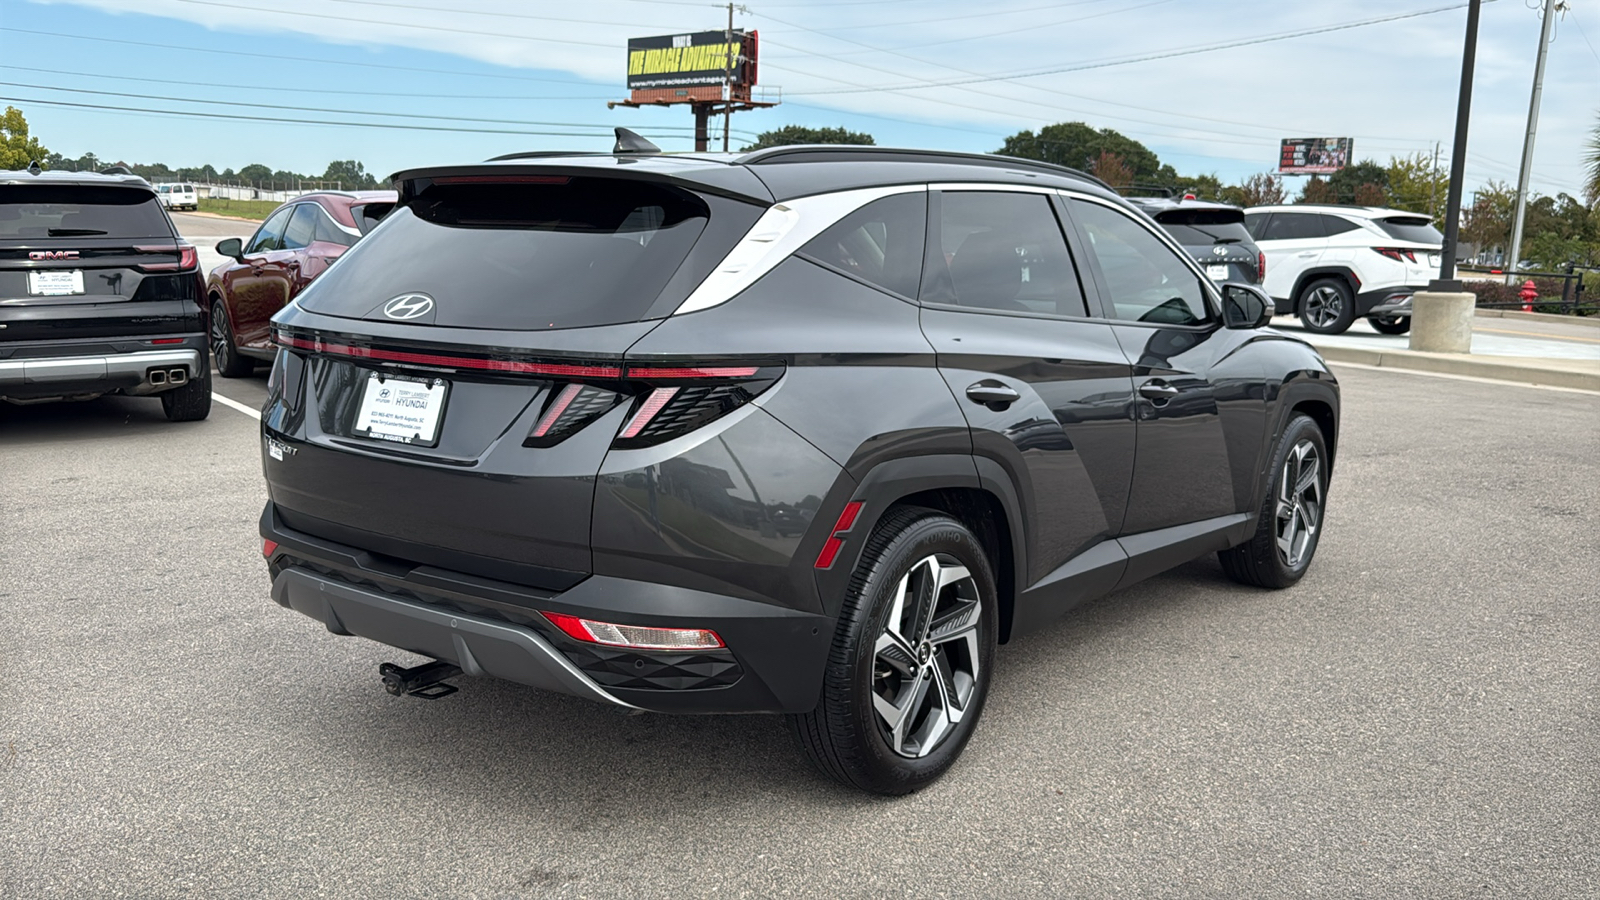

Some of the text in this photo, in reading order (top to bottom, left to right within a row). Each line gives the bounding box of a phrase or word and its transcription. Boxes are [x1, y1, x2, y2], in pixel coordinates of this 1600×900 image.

[629, 42, 741, 75] THE MIRACLE ADVANTAG?
[29, 251, 80, 260] GMC
[395, 398, 429, 409] HYUNDAI
